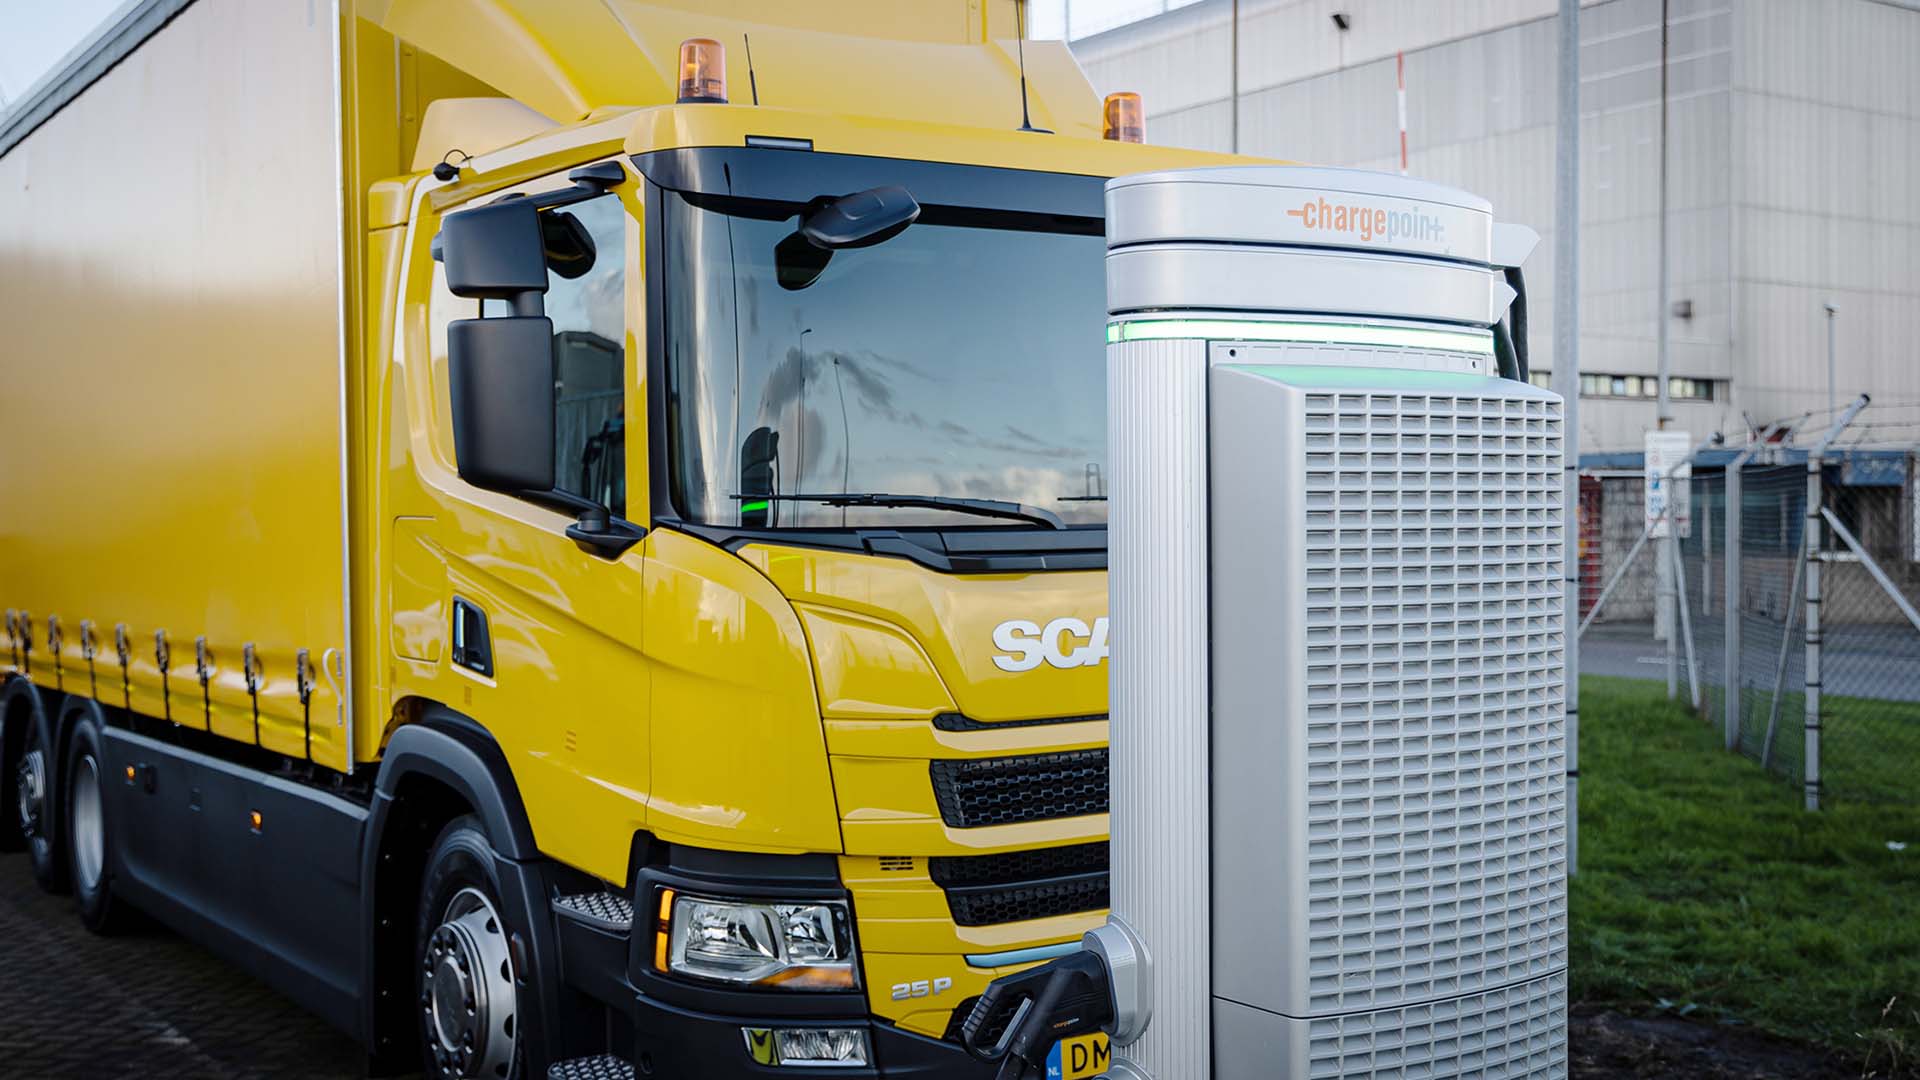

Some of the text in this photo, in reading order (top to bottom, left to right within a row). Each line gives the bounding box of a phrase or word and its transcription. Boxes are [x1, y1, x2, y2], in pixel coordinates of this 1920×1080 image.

[891, 976, 952, 1001] 25 P
[1047, 1039, 1112, 1077] NL DM
